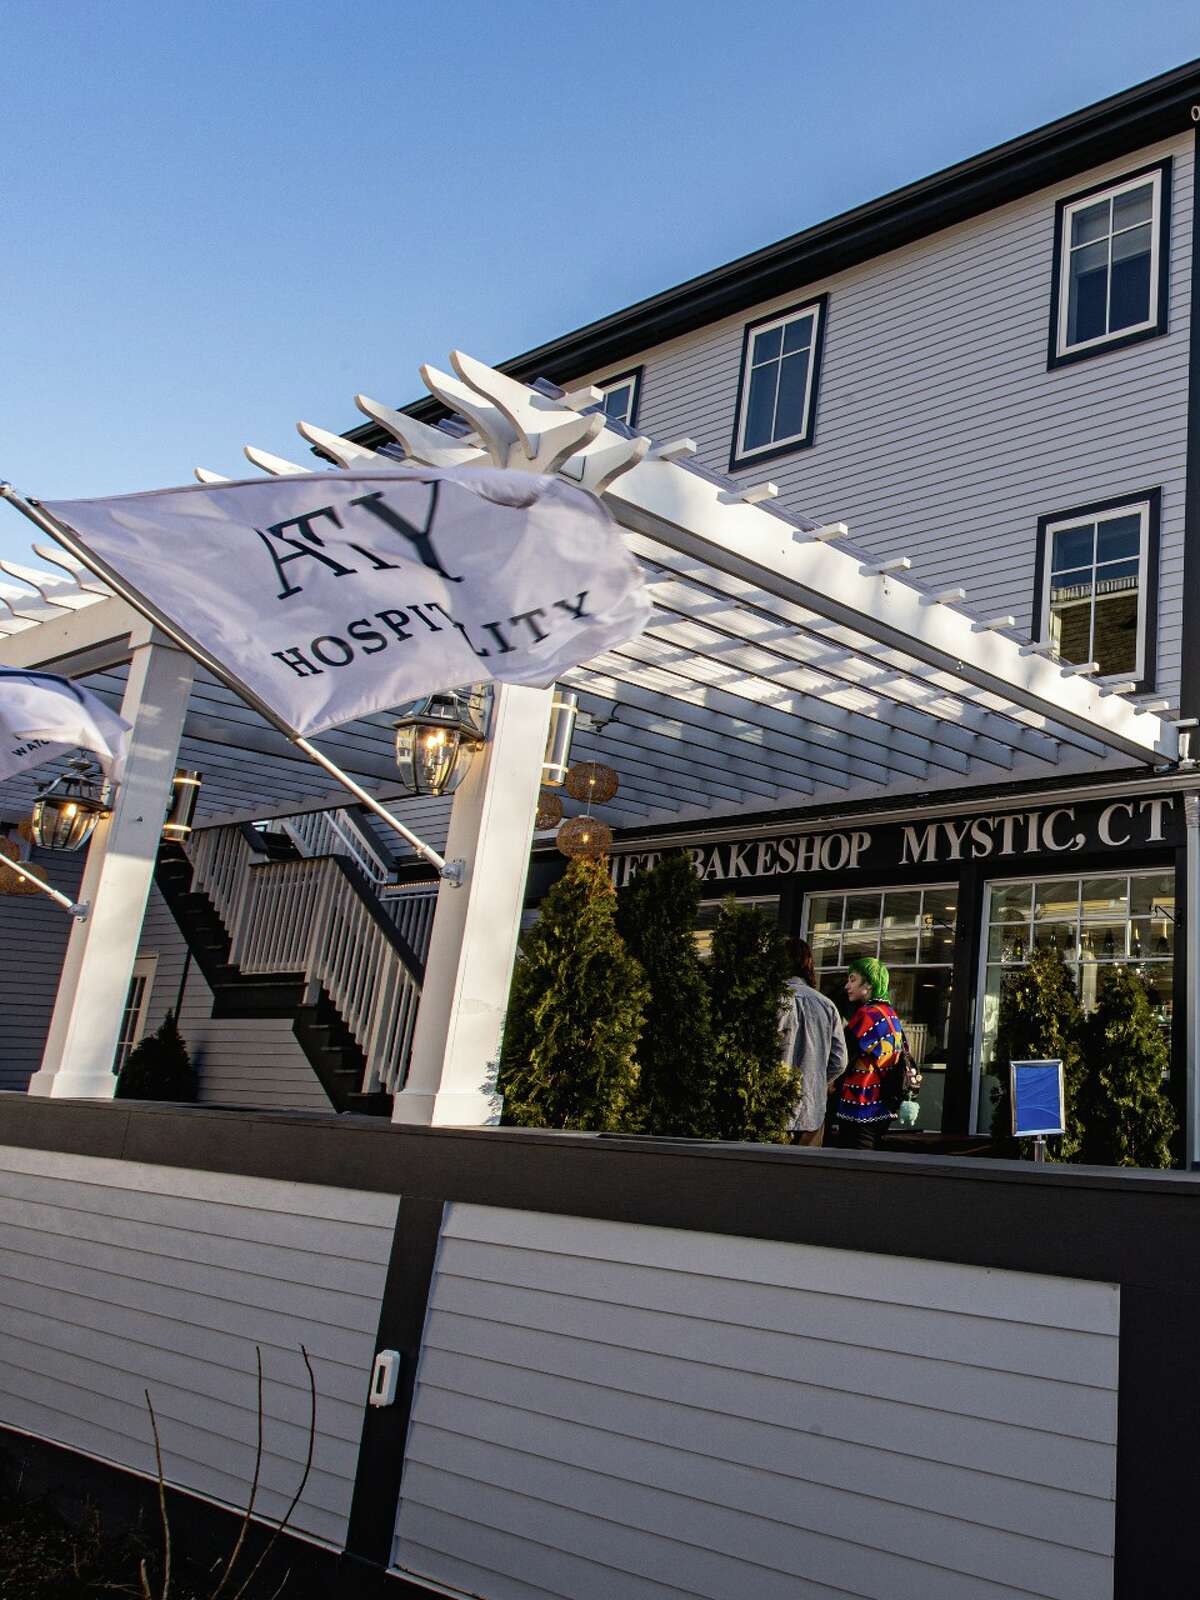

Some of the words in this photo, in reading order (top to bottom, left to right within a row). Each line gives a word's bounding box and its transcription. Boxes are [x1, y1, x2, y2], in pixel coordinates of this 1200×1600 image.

[270, 590, 592, 678] HOSPITLITY
[608, 852, 664, 888] IFT
[683, 831, 872, 881] BAKESHOP
[898, 807, 1087, 865] MYSTIC,
[1097, 797, 1175, 847] CT
